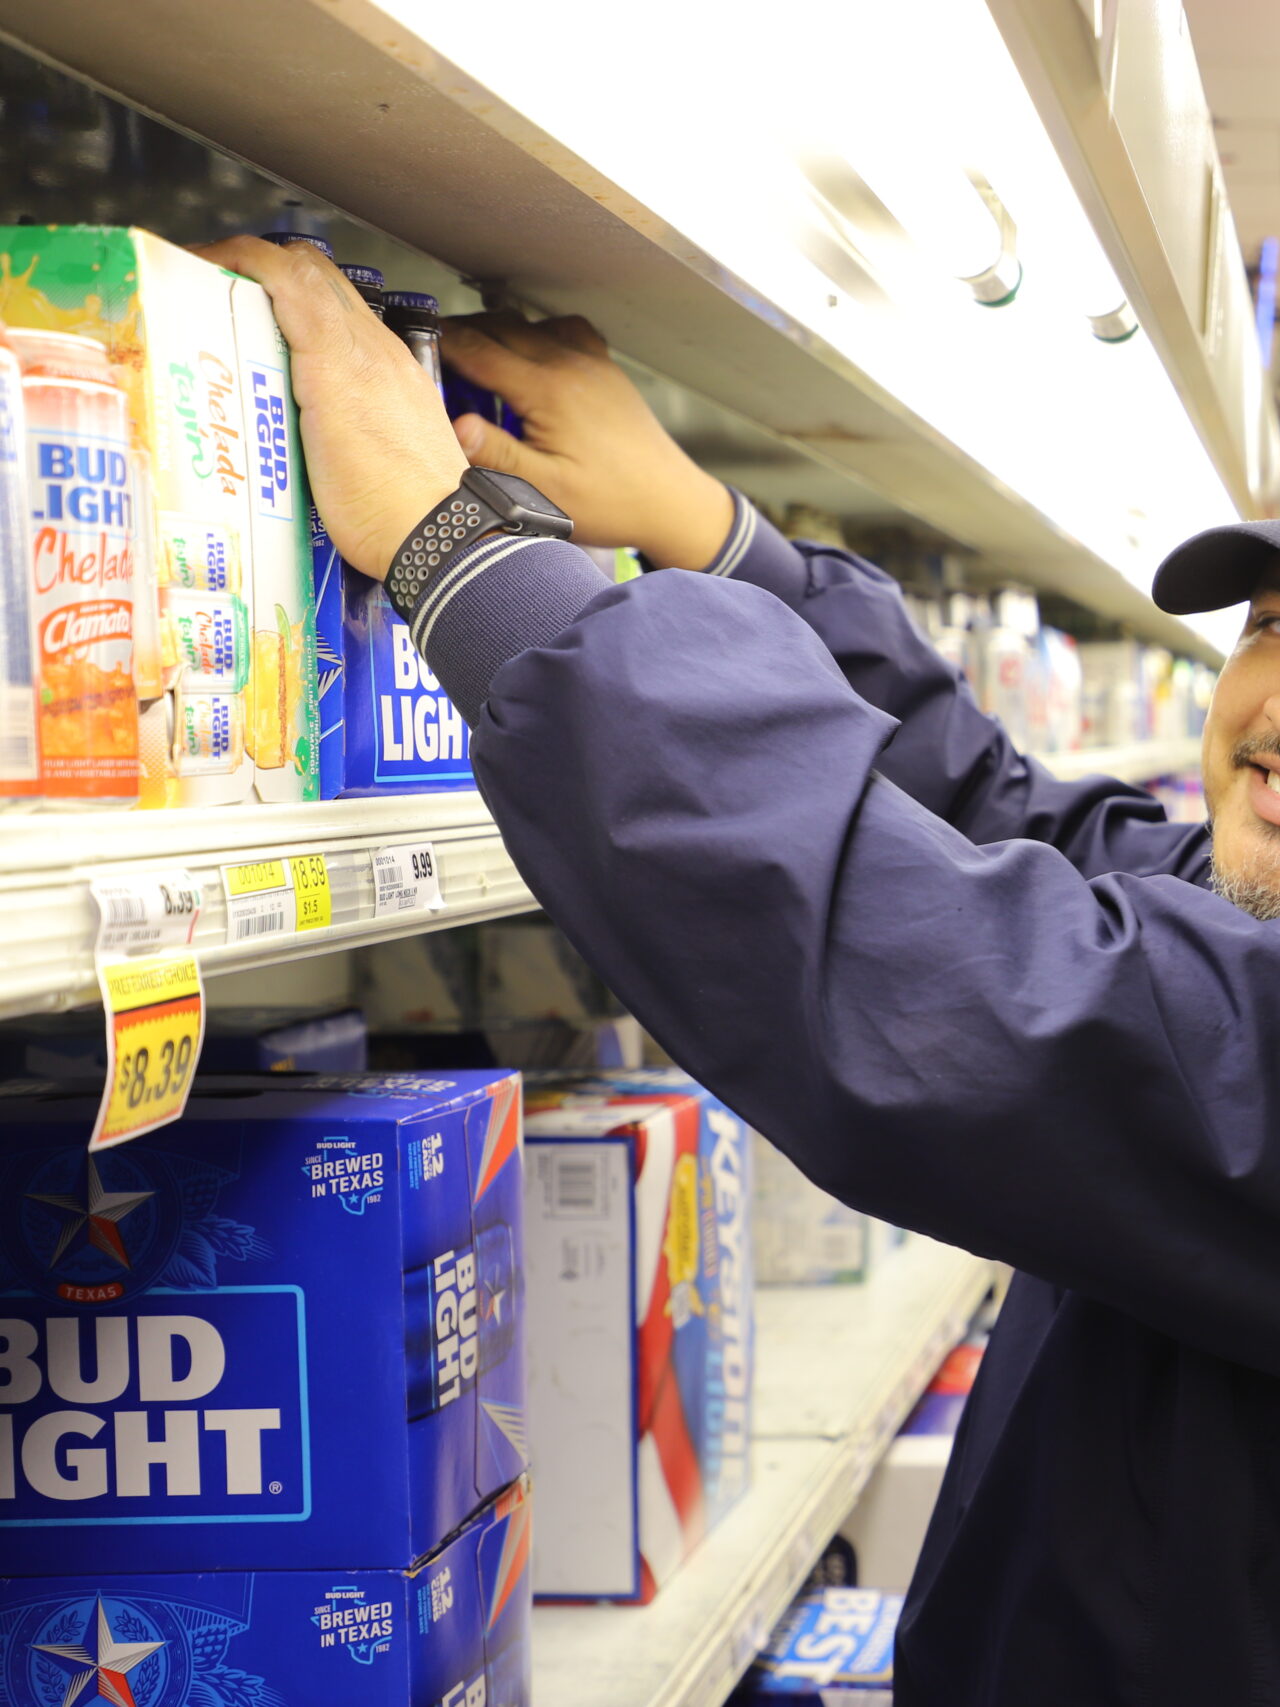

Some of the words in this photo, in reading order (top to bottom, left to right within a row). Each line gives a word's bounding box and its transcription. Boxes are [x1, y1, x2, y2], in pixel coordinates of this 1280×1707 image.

[199, 351, 245, 496] Chelada
[252, 371, 275, 508] LIGHT
[269, 395, 288, 491] BUD
[37, 443, 127, 487] BUD
[216, 542, 226, 590] BUD
[43, 606, 129, 654] Clamato
[213, 610, 224, 677] LIGHT
[223, 619, 232, 669] BUD
[212, 698, 221, 759] LIGHT
[220, 705, 229, 752] BUD
[381, 695, 472, 762] LIGH
[292, 857, 326, 891] 18.59
[412, 851, 432, 879] 9.99
[163, 963, 198, 985] CHOICE
[119, 1035, 192, 1109] $8.39
[311, 1152, 383, 1180] BREWED
[312, 1183, 326, 1198] IN
[329, 1170, 384, 1194] TEXAS
[66, 1286, 117, 1300] TEXAS
[455, 1252, 477, 1380] BUD
[433, 1249, 461, 1407] LIGHT
[320, 1601, 392, 1630] BREWED
[342, 1591, 365, 1599] LIGHT
[321, 1633, 335, 1648] IN
[338, 1619, 393, 1644] TEXAS
[774, 1587, 881, 1685] BEST
